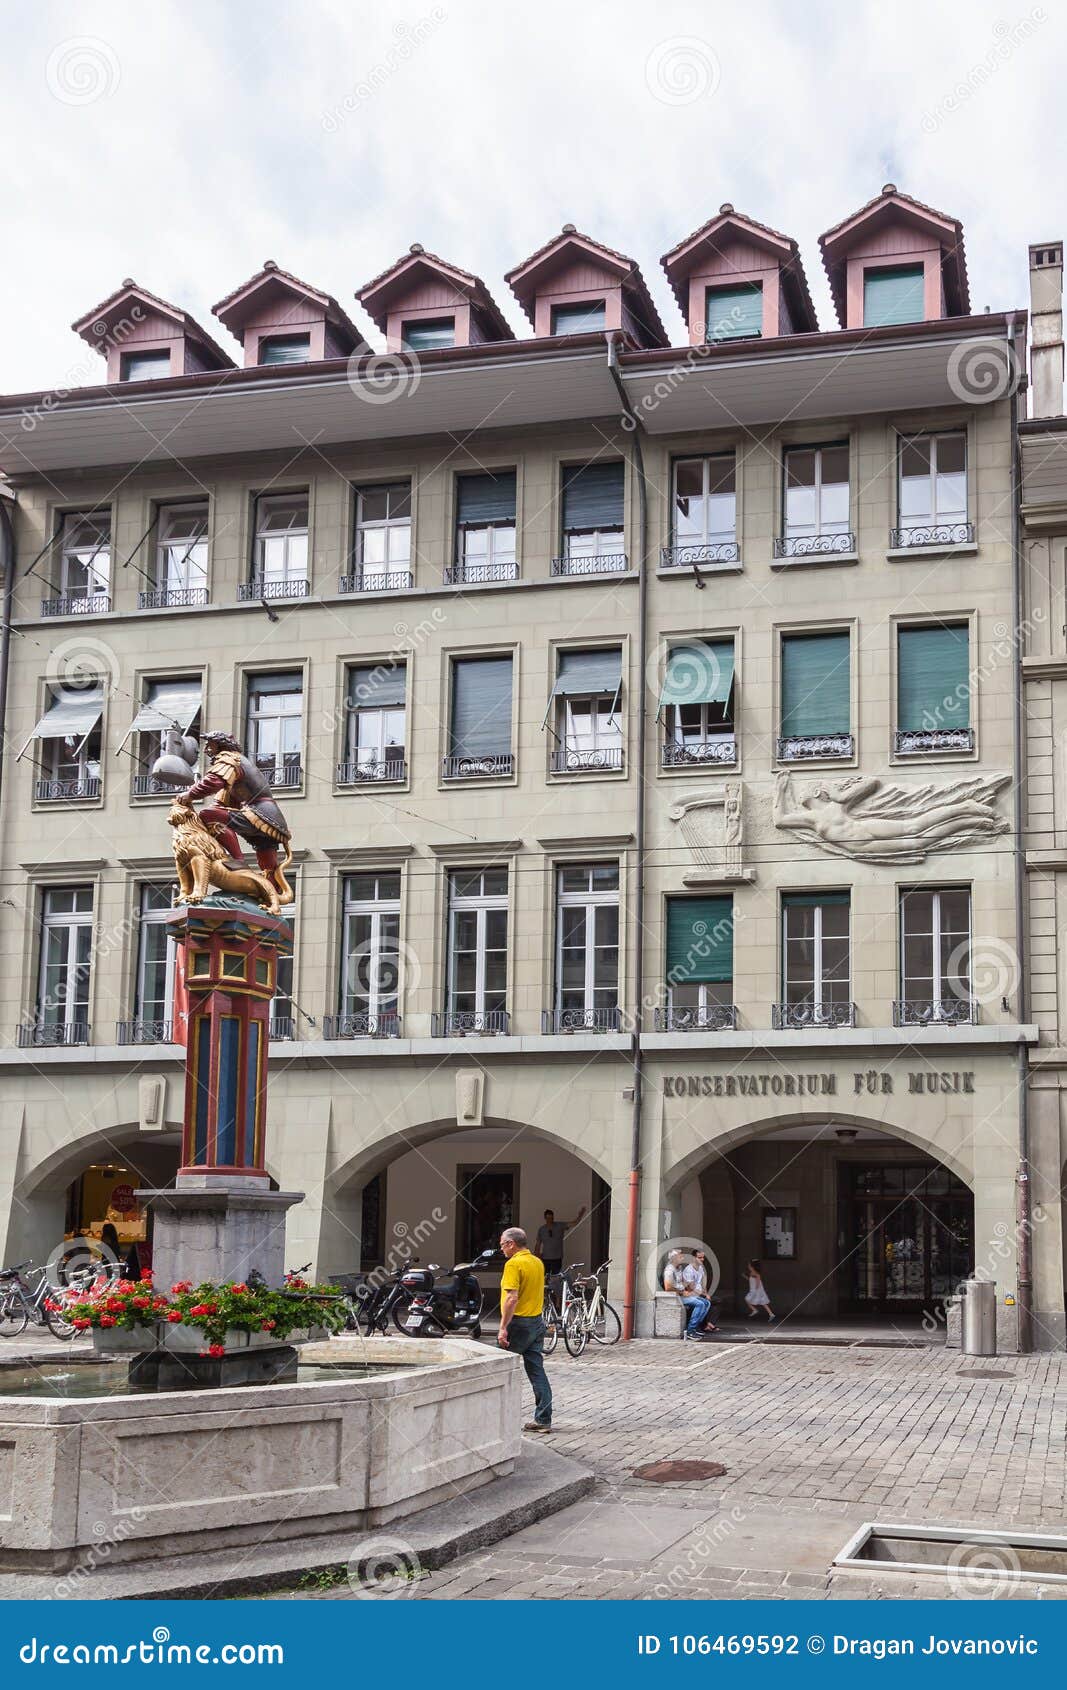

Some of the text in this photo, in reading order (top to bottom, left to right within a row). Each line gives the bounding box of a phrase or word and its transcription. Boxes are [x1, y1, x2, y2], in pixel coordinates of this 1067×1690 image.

[662, 1070, 976, 1097] KONSERVATORIUM FÜR MUSIK
